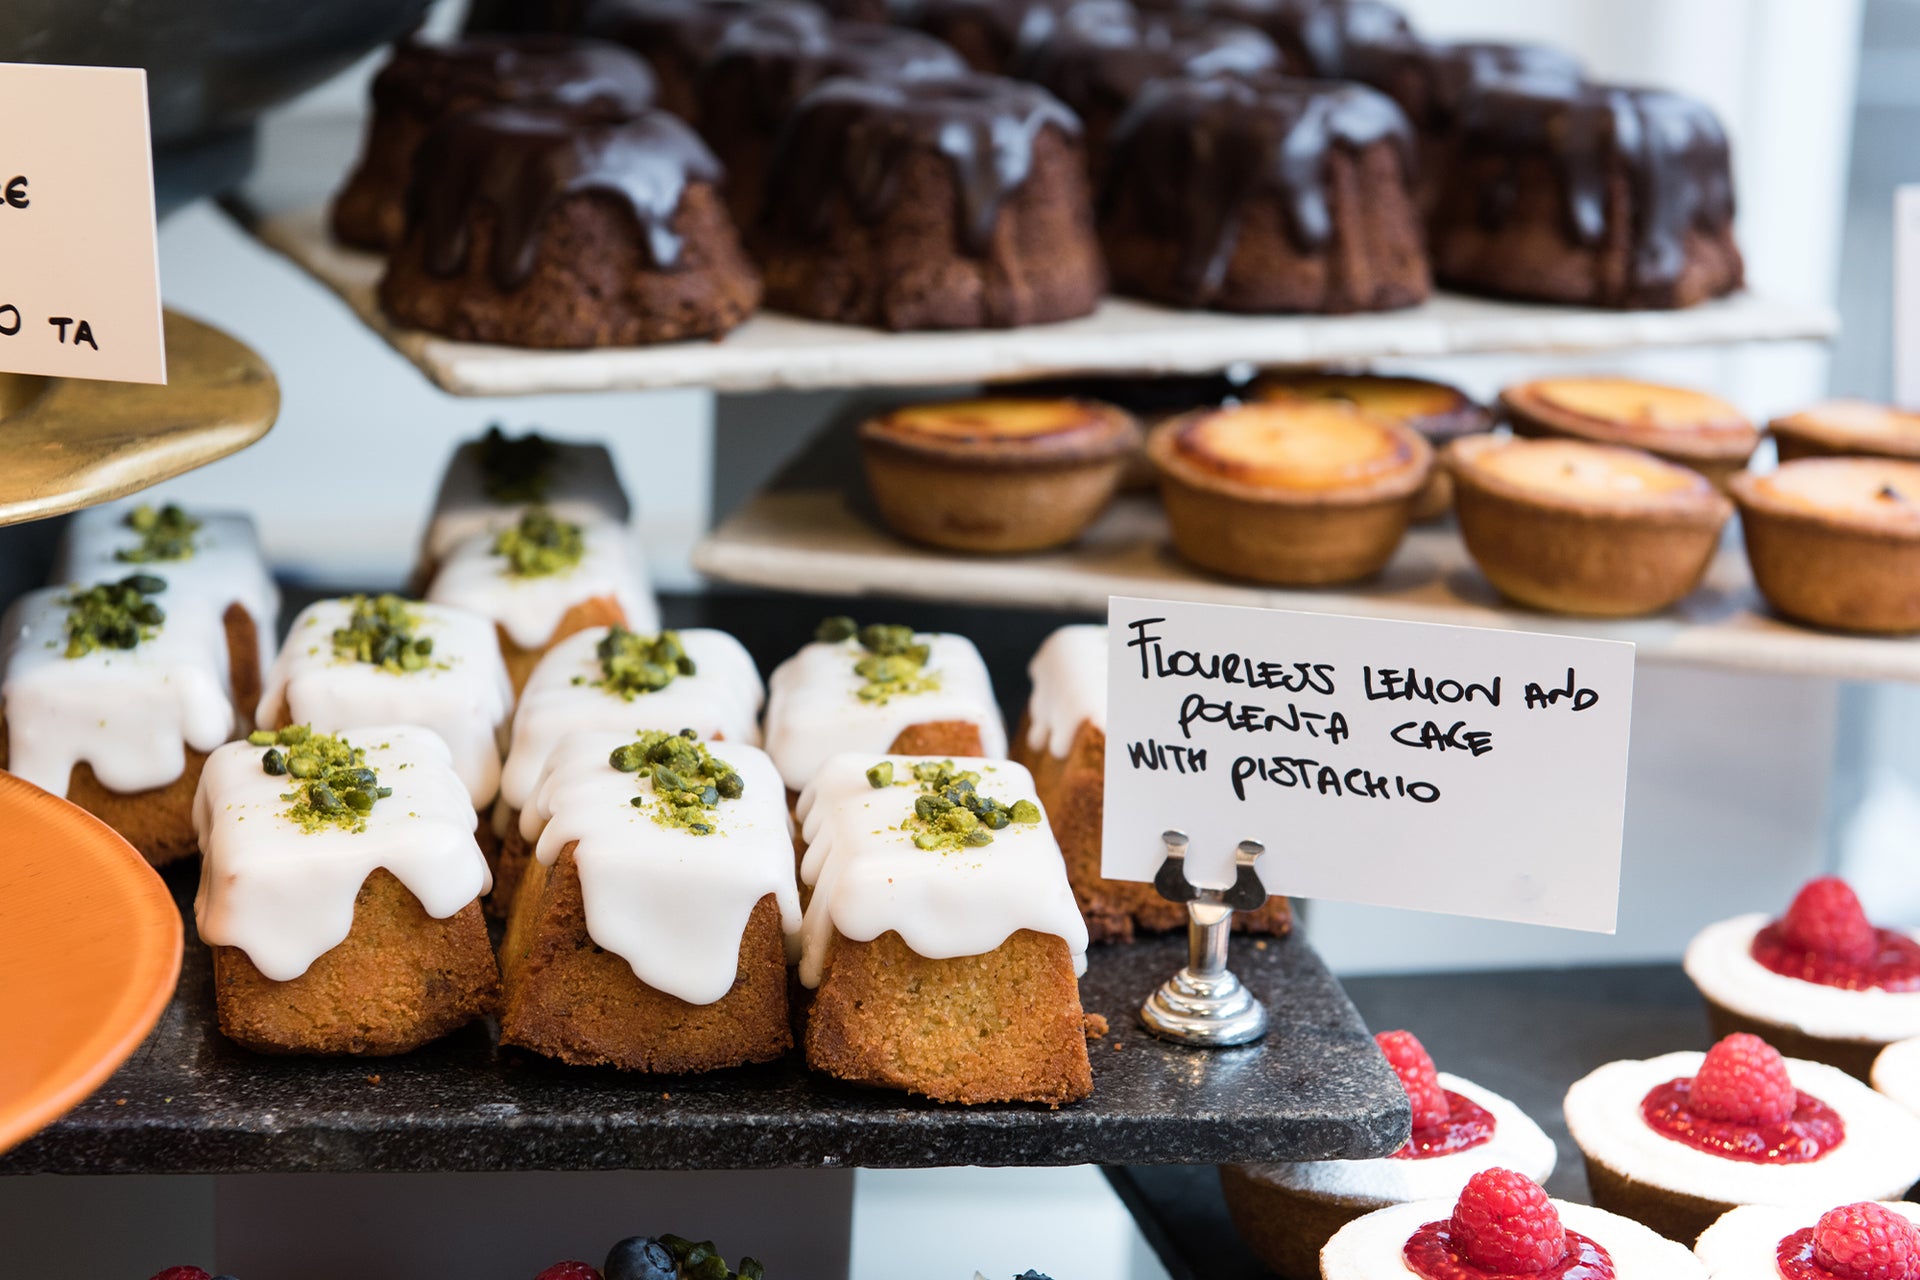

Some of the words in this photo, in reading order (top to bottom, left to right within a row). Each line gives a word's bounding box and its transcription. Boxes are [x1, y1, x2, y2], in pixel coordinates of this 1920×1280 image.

[48, 316, 99, 351] TA
[1127, 617, 1335, 696] FLOURLESS
[1363, 665, 1501, 707] LEMON
[1177, 693, 1349, 745] POLENTA
[1390, 720, 1493, 757] CAKE
[1127, 738, 1207, 774] WITH
[1231, 756, 1441, 803] PISTACHIO
